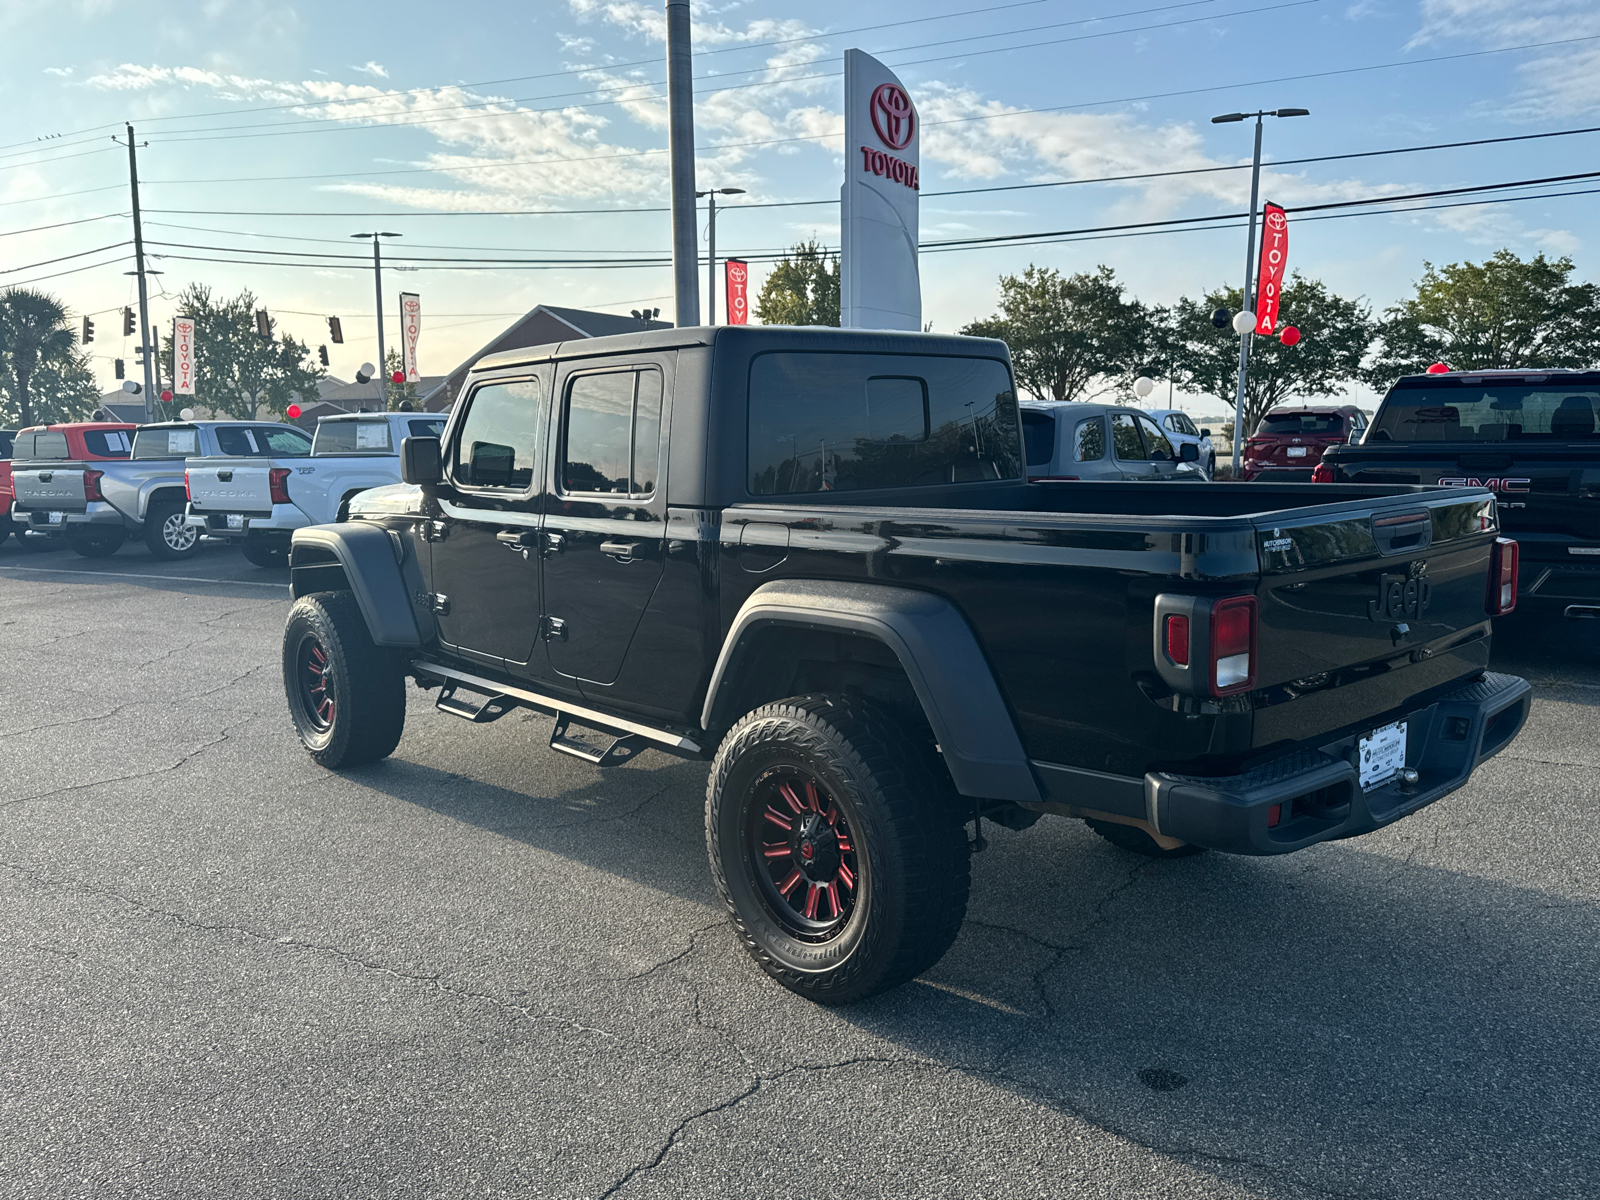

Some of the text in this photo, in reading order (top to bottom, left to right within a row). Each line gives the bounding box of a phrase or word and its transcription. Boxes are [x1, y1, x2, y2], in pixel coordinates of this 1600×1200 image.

[861, 146, 919, 191] TOYOTA
[1261, 233, 1282, 329] TOYOTA
[734, 284, 745, 322] TOY
[180, 335, 189, 388] TOYOTA
[200, 490, 257, 498] TACOMA
[1438, 477, 1530, 493] GMC
[1263, 537, 1292, 548] HUTCHINSON
[1367, 573, 1432, 622] Jeep
